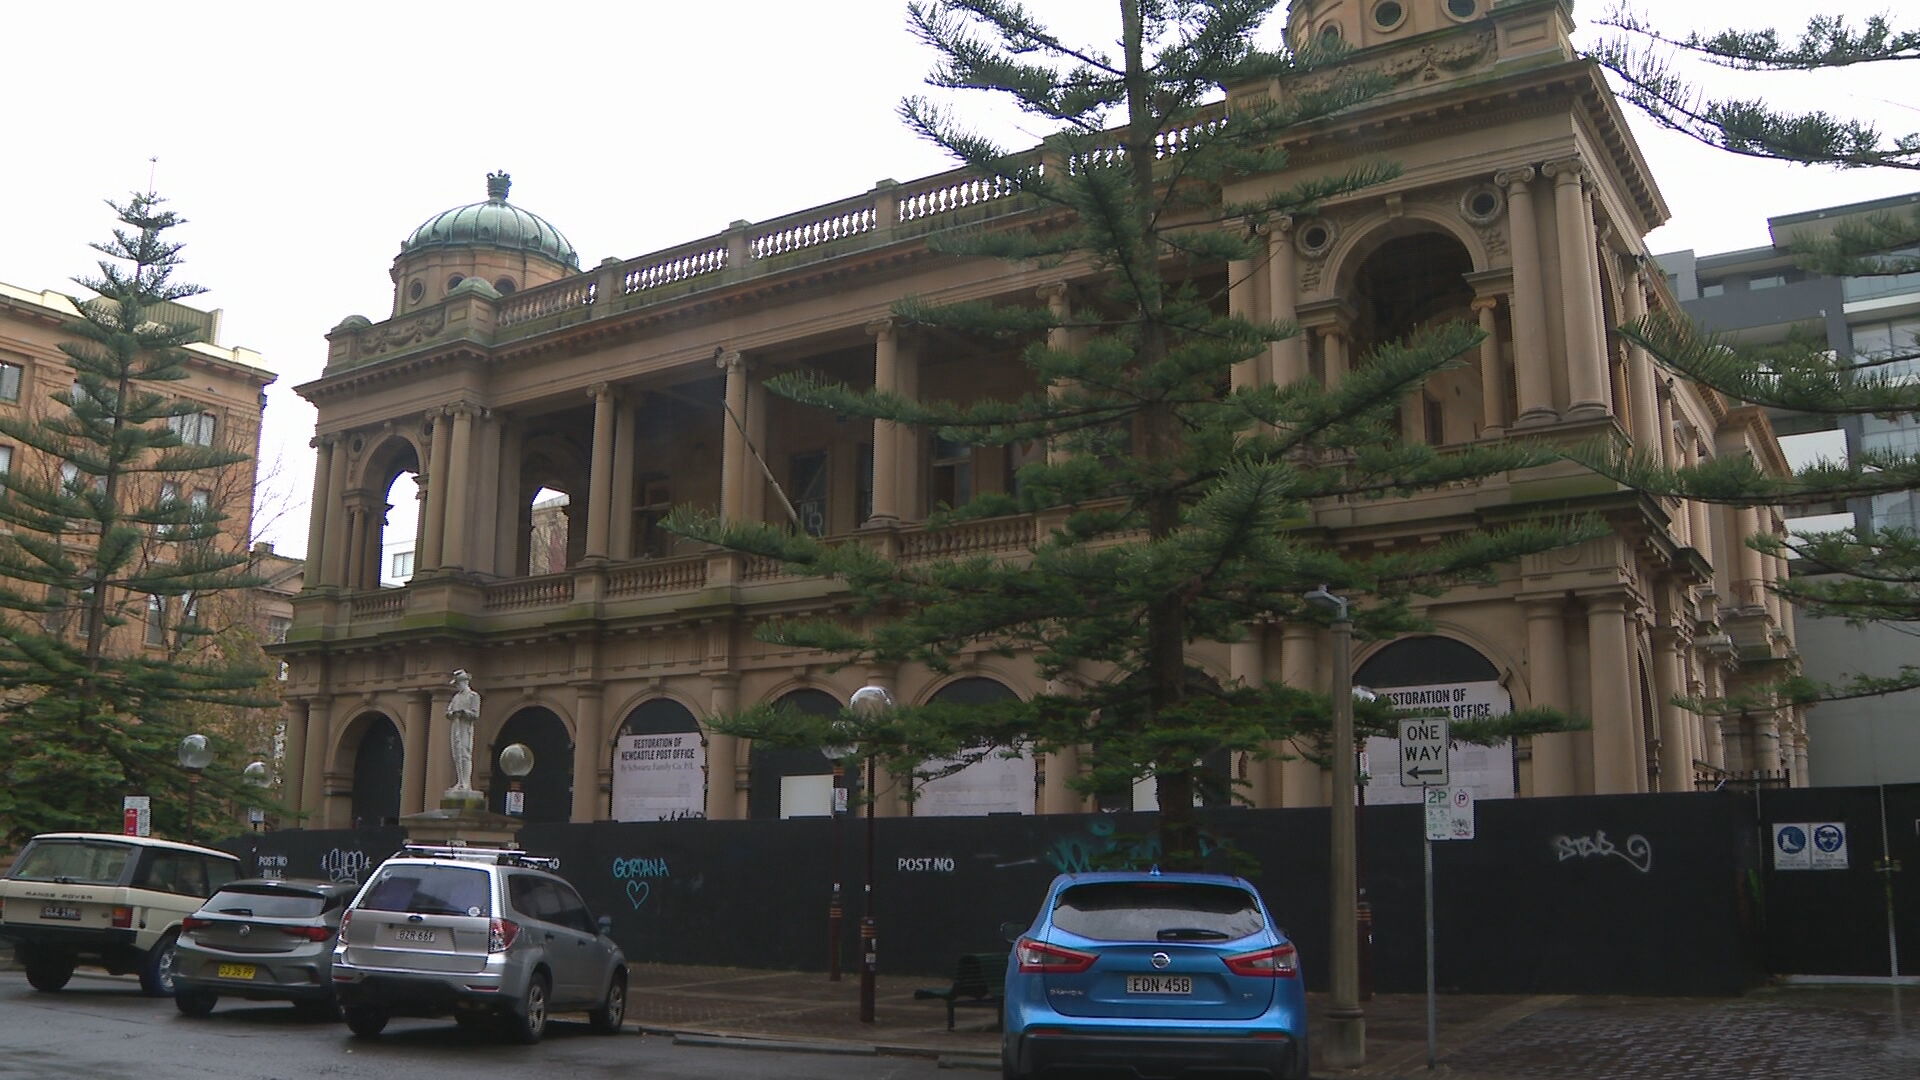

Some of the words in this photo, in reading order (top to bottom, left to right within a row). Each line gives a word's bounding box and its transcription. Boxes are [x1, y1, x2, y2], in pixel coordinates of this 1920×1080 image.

[1381, 689, 1450, 706] STORATION
[1453, 688, 1467, 702] OF
[1453, 703, 1491, 719] OFFICE
[1407, 725, 1440, 741] ONE
[633, 738, 673, 749] RESTORATION
[674, 737, 683, 748] OF
[621, 750, 655, 761] NEWCASTLE
[656, 749, 672, 760] POST
[673, 748, 695, 759] OFFICE
[1404, 745, 1442, 762] WAY
[1428, 791, 1448, 804] 2P
[259, 856, 278, 867] POST
[897, 858, 932, 871] POST
[934, 858, 955, 872] NO
